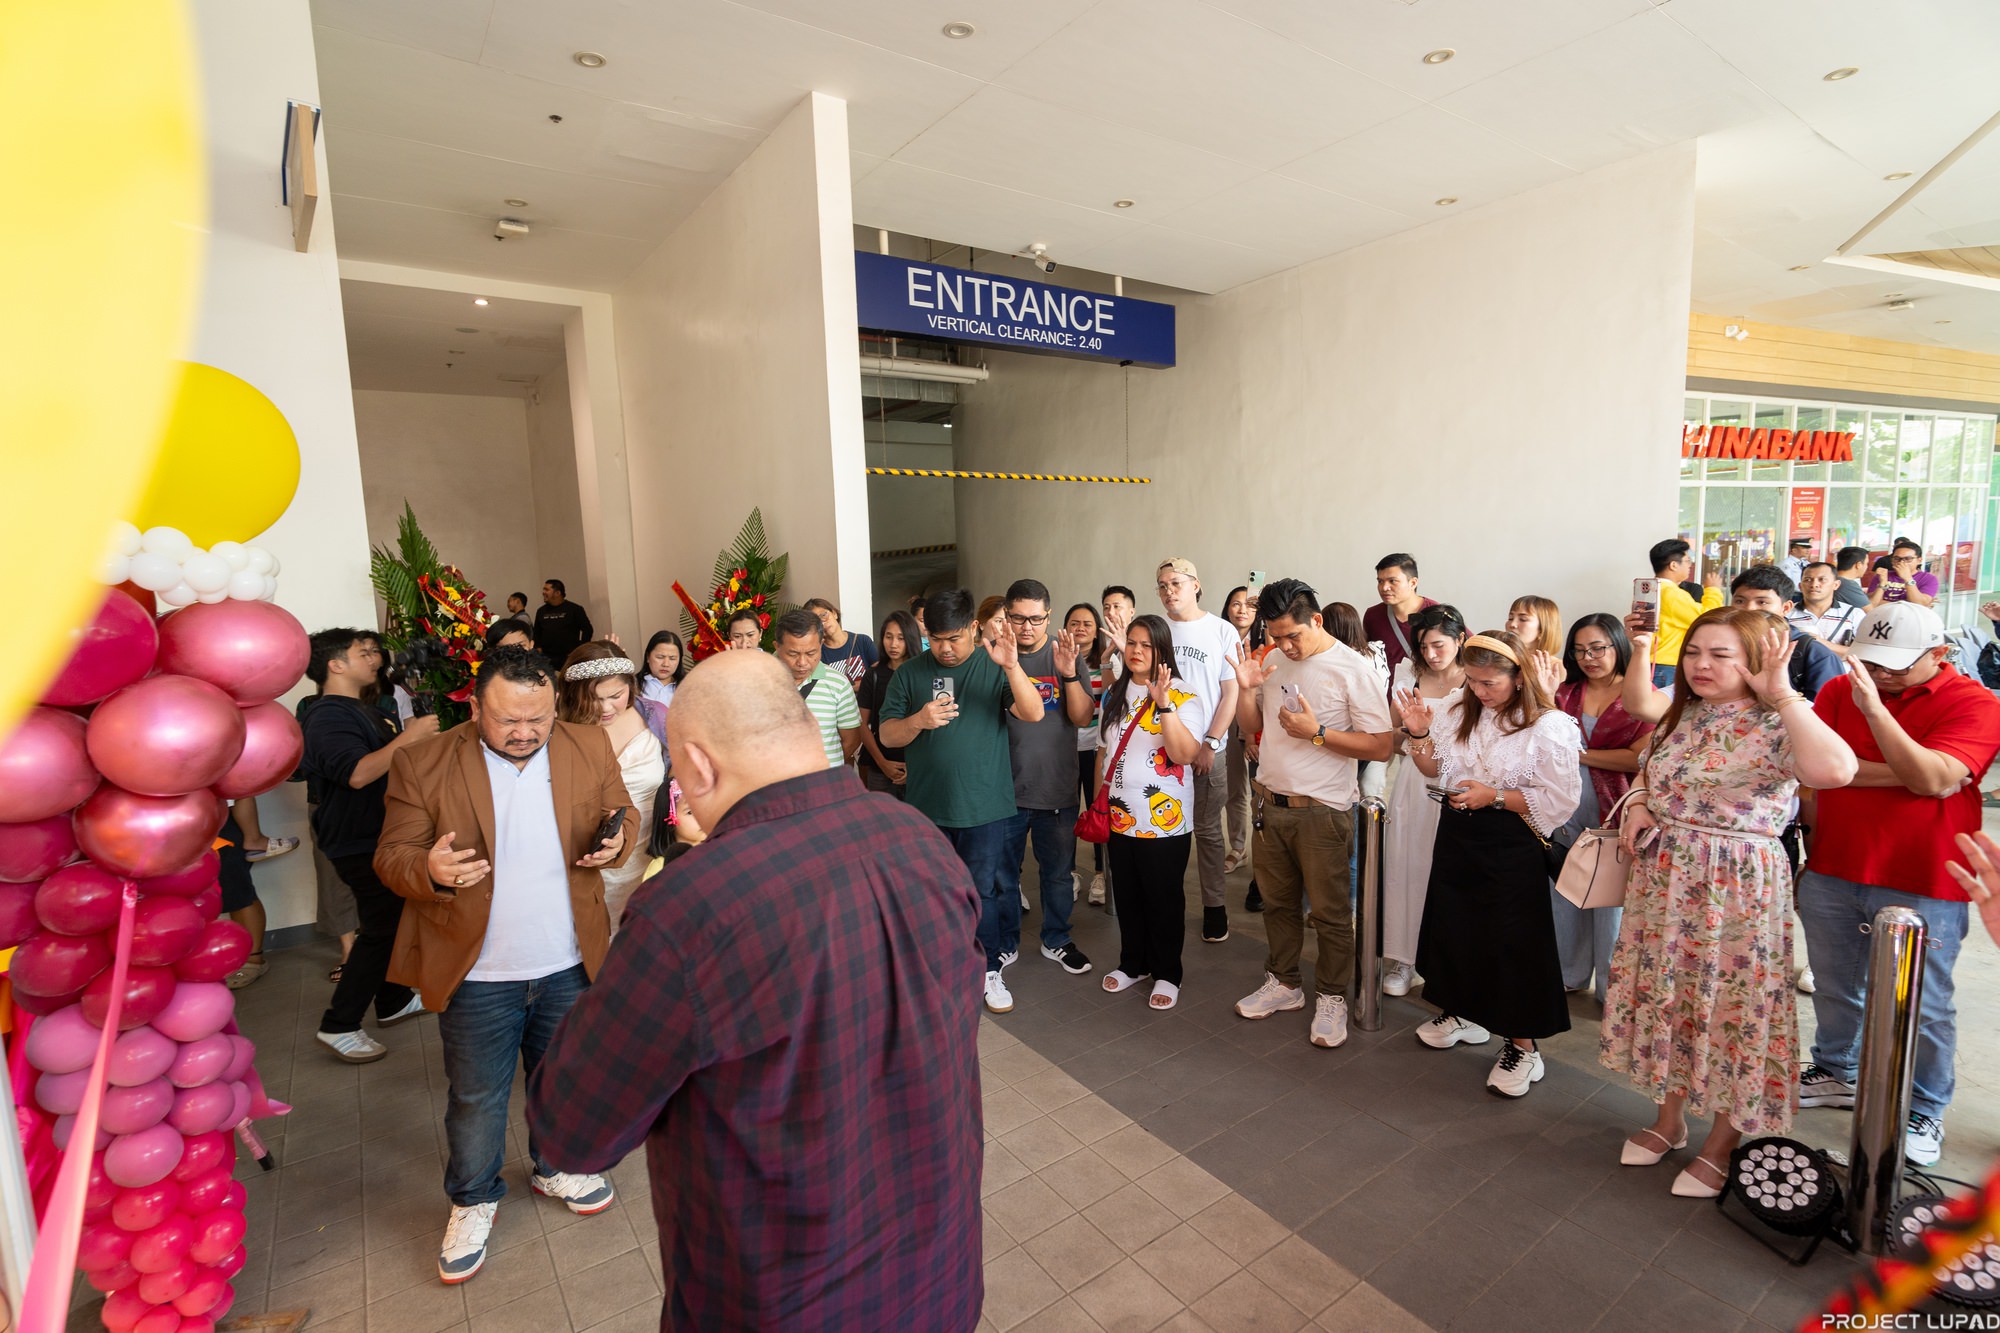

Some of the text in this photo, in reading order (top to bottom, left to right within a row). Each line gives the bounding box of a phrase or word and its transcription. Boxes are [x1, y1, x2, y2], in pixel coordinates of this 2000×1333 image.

[907, 266, 1115, 335] ENTRANCE
[927, 314, 1102, 350] VERTICAL CLEARANCE: 2.40
[1682, 424, 1857, 461] HINABANK
[1182, 645, 1208, 664] YORK
[1114, 758, 1125, 789] SESAME
